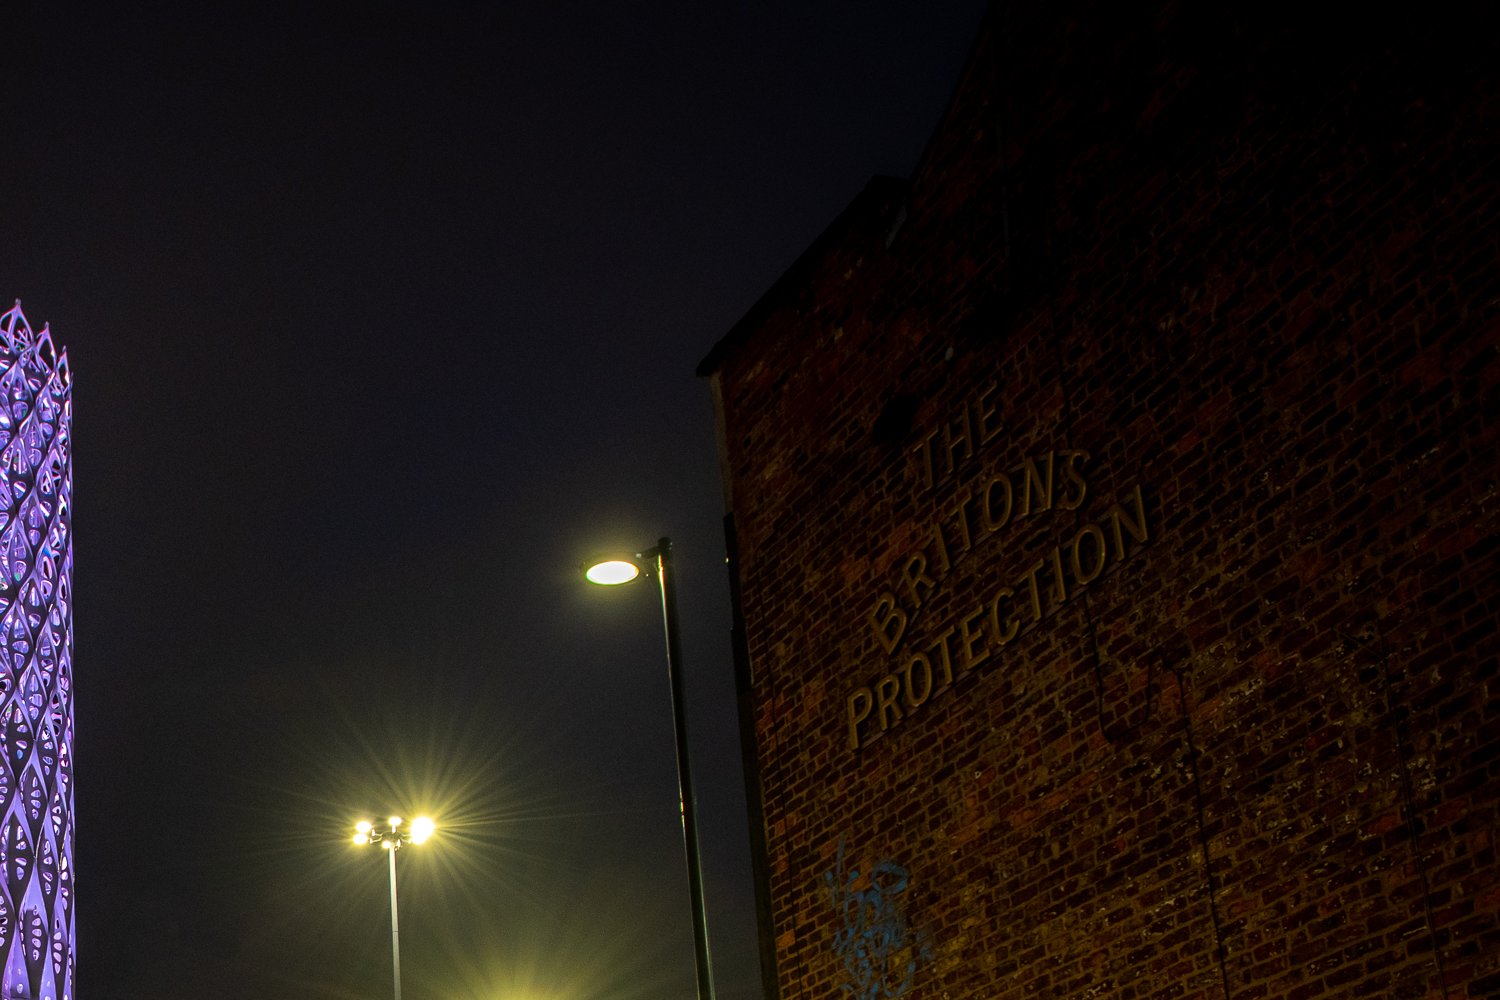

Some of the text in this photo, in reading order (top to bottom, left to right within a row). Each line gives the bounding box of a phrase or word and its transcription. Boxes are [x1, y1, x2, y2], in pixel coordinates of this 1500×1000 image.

[912, 380, 1005, 492] THE
[846, 484, 1150, 752] PROTECTION
[866, 447, 1091, 655] BRITONS
